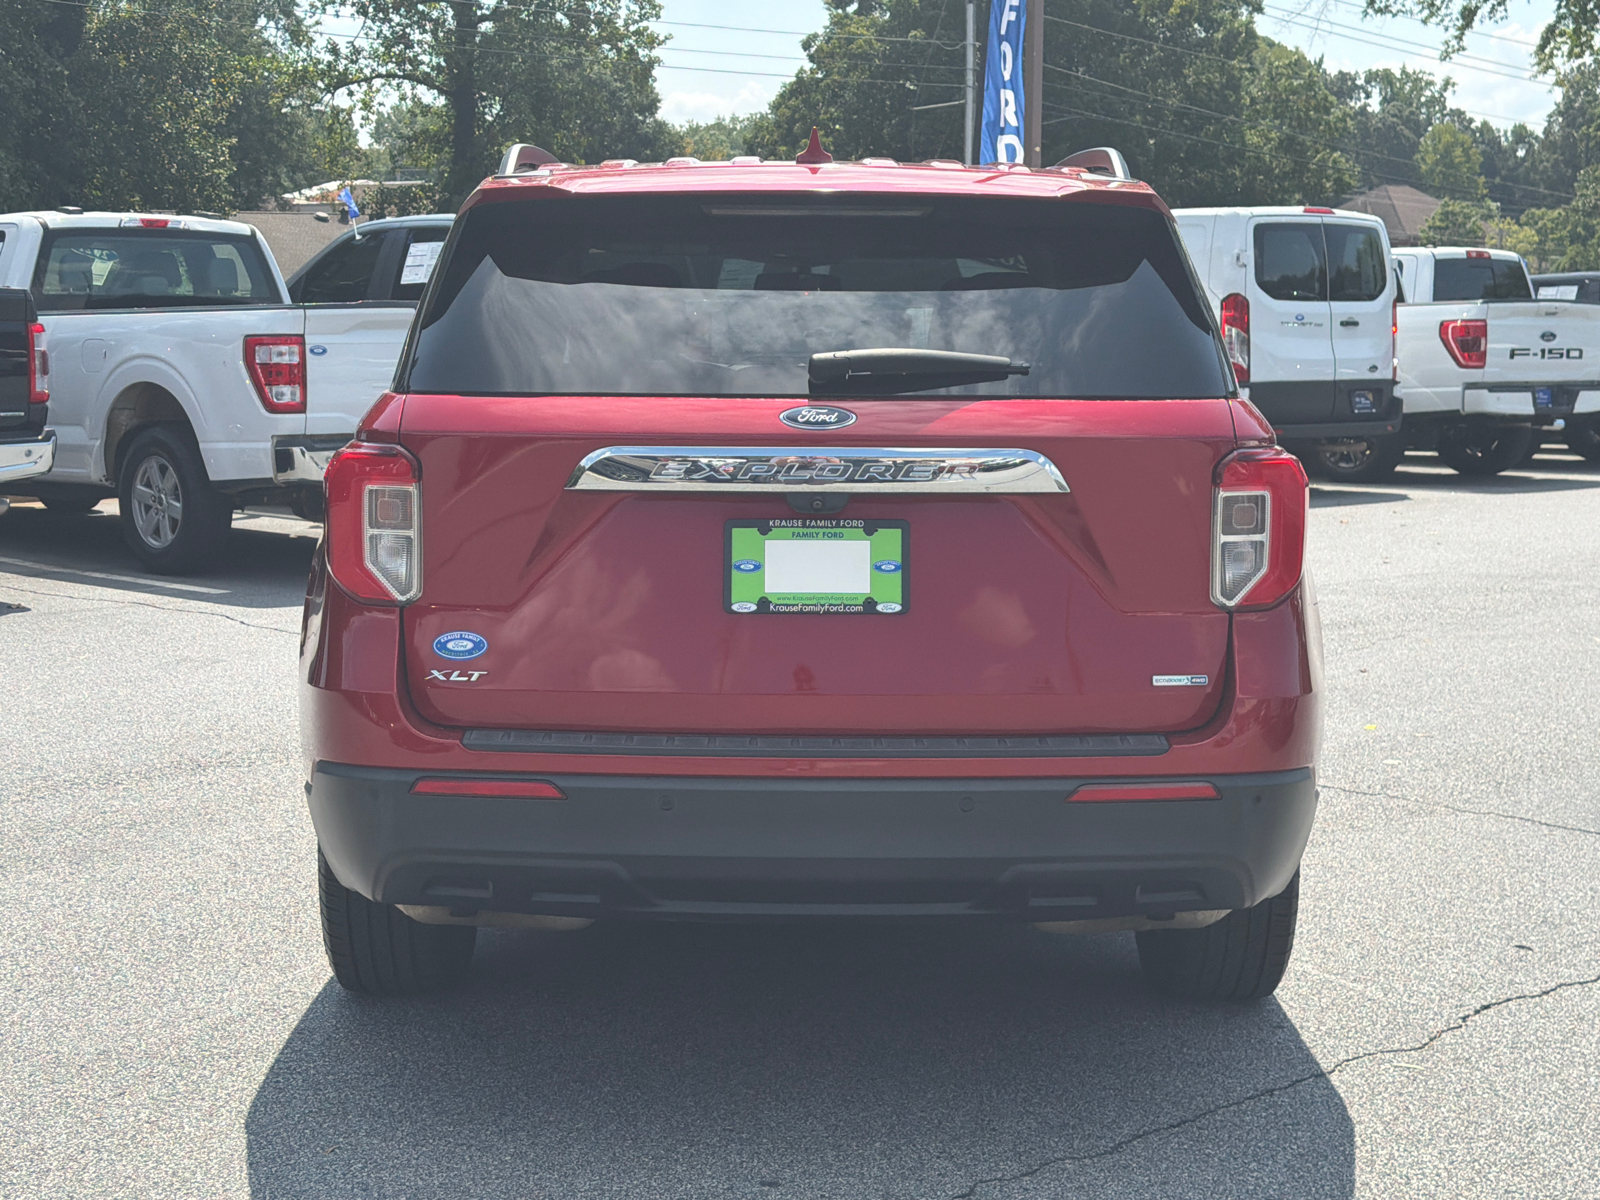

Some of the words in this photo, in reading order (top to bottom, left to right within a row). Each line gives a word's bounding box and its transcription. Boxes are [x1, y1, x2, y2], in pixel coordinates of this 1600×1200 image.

[997, 0, 1024, 164] FORD
[1509, 348, 1583, 359] F-150
[797, 409, 838, 422] Ford
[648, 461, 980, 481] EXPLORER
[769, 519, 803, 527] KRAUSE
[806, 519, 837, 527] FAMILY
[791, 531, 820, 539] FAMILY
[822, 531, 845, 539] FORD
[769, 603, 864, 614] KrauseFamilyFord.com
[440, 633, 461, 642] KRAUSE
[462, 633, 480, 642] FAMILY
[451, 641, 469, 649] Ford
[424, 669, 488, 681] XLT
